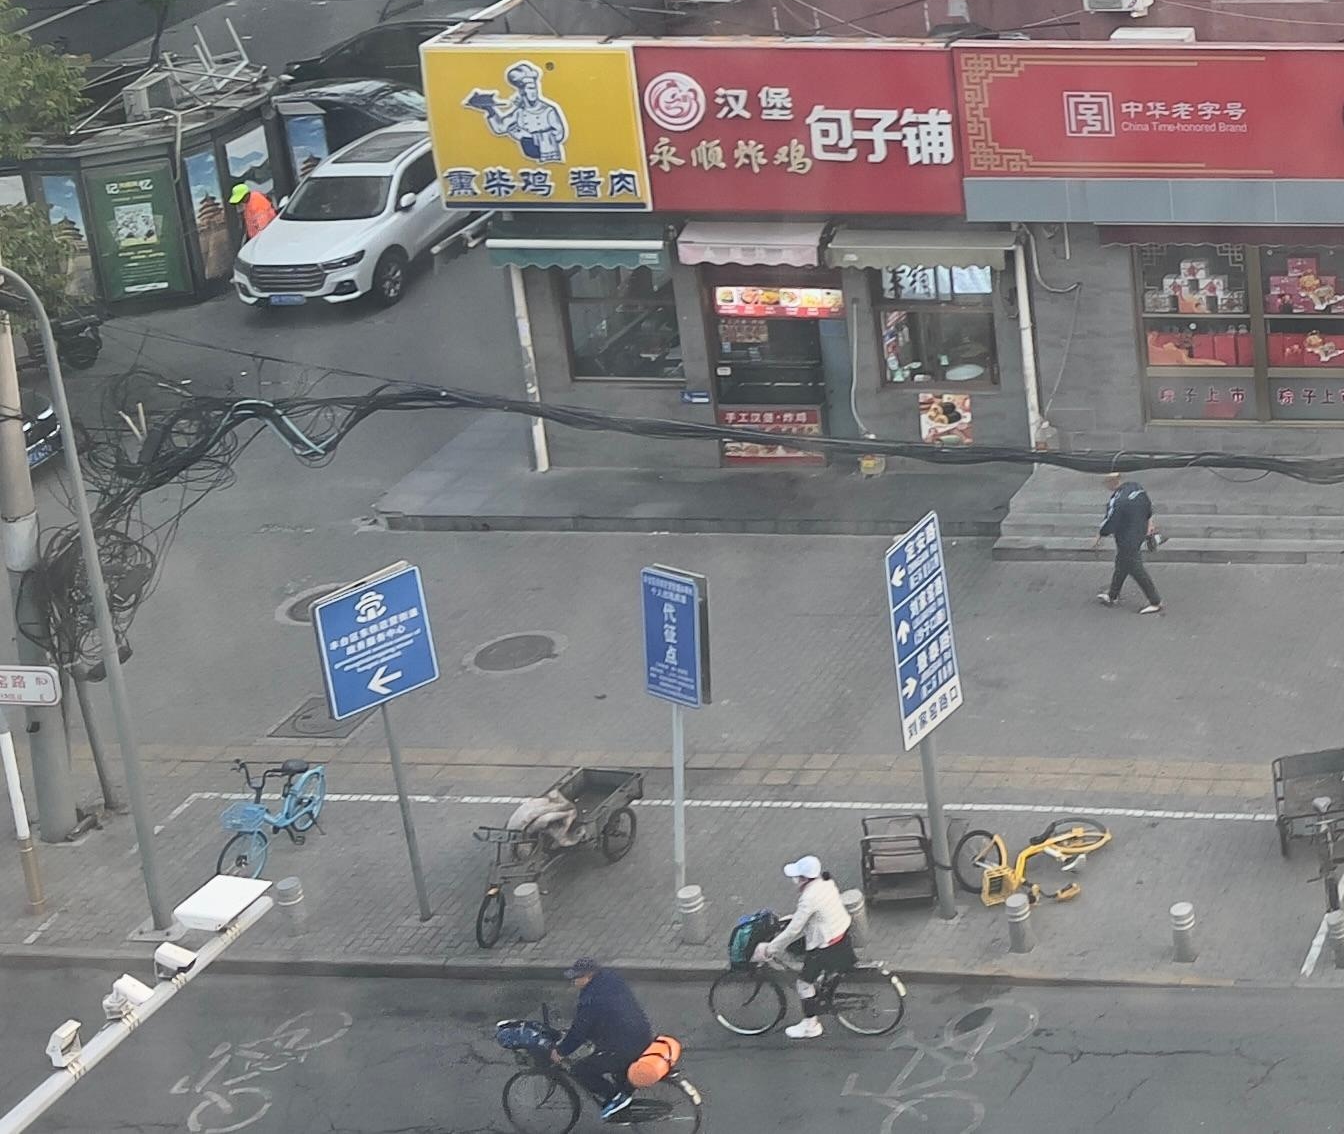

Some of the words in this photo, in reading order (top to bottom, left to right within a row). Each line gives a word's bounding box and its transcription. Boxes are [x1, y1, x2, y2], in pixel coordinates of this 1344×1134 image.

[714, 86, 794, 120] 汉堡
[1121, 101, 1247, 121] 中华老字号
[805, 105, 955, 165] 包子铺
[1121, 122, 1150, 132] China
[1152, 122, 1217, 132] Time-honored
[1218, 122, 1248, 133] Brand
[650, 137, 813, 174] 永顺炸鸡
[570, 168, 641, 198] 酱肉
